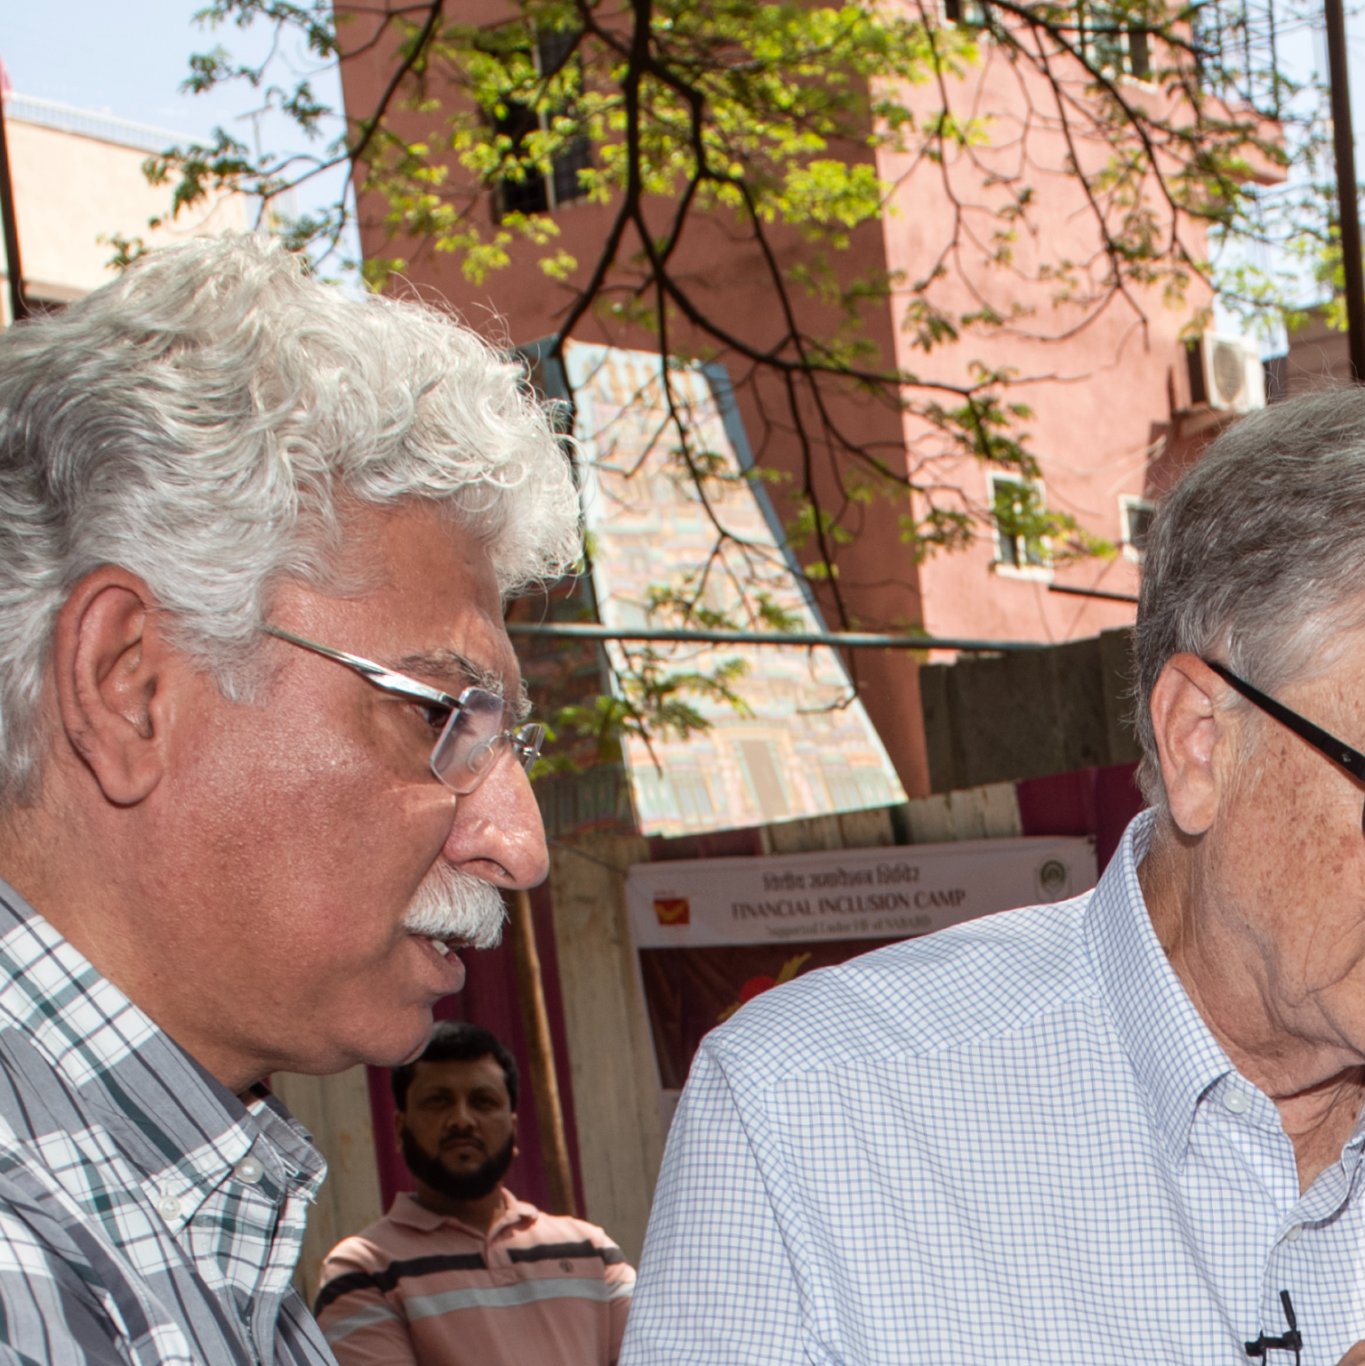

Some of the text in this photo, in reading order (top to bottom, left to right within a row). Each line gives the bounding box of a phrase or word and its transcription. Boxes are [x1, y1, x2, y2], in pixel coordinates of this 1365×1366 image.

[731, 888, 966, 920] FINANCIAL INCLUSION CAMP
